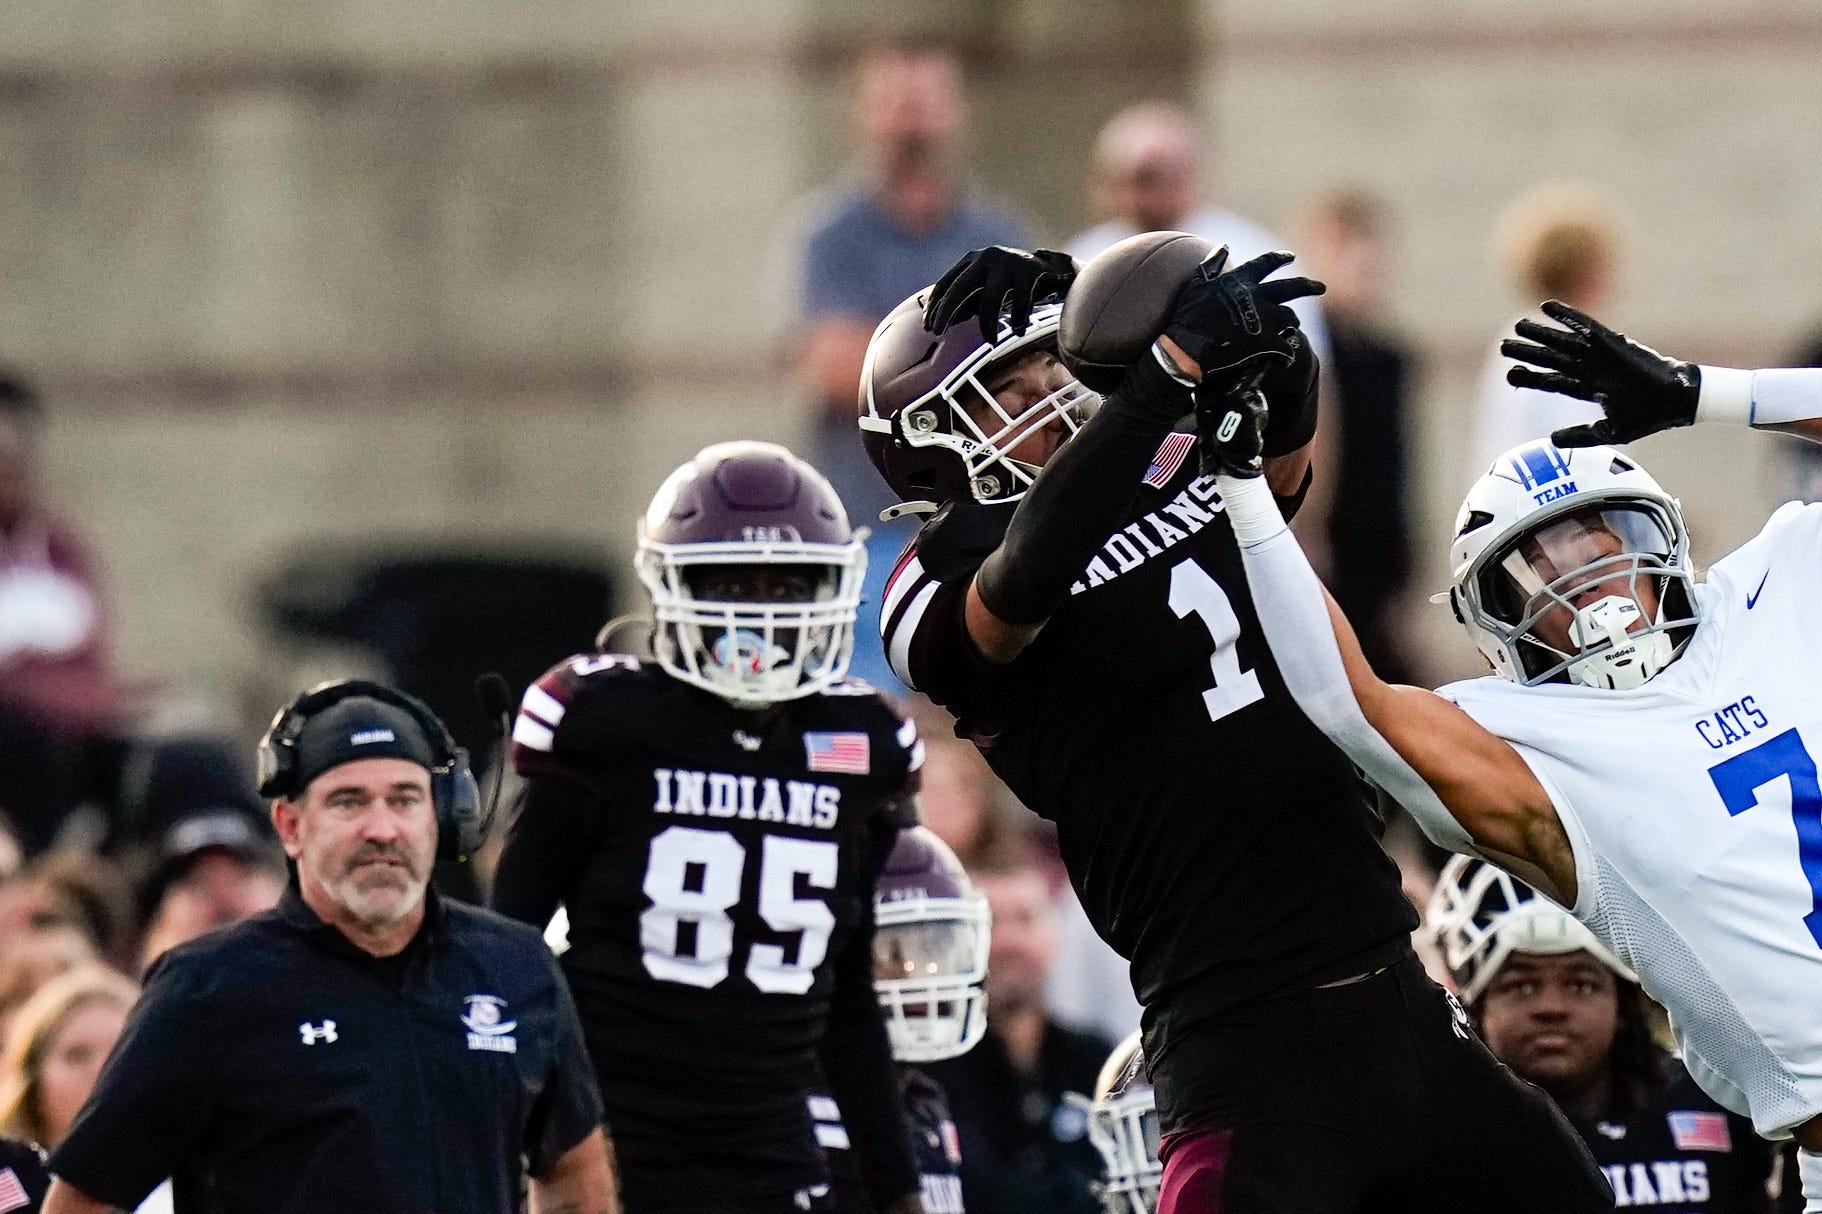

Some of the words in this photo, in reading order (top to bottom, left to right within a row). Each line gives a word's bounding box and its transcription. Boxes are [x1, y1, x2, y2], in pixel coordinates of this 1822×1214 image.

[1533, 481, 1579, 506] TEAM
[1168, 557, 1265, 722] 1
[1605, 646, 1636, 662] Riddell
[1695, 695, 1768, 749] CATS
[653, 768, 842, 829] INDIANS
[639, 825, 839, 995] 85
[1601, 1159, 1711, 1208] IANS
